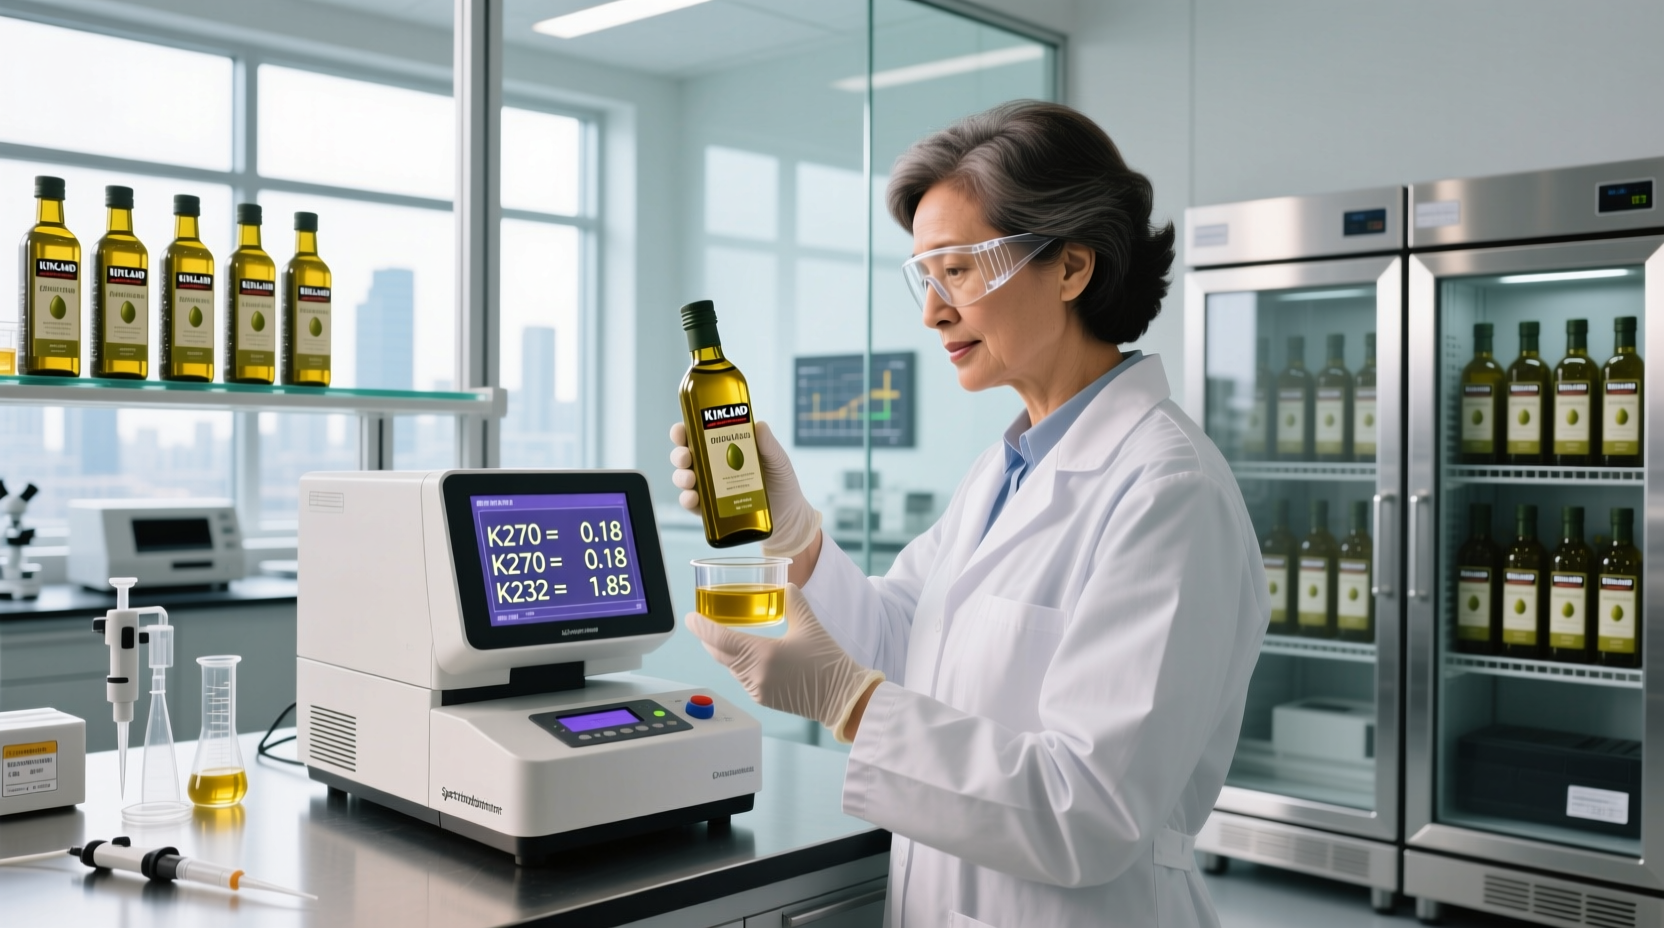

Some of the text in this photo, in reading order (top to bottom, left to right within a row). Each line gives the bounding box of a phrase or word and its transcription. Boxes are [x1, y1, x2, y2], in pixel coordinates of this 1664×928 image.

[580, 520, 623, 543] 0.18
[584, 546, 628, 570] 0.18
[589, 574, 631, 597] 1.85
